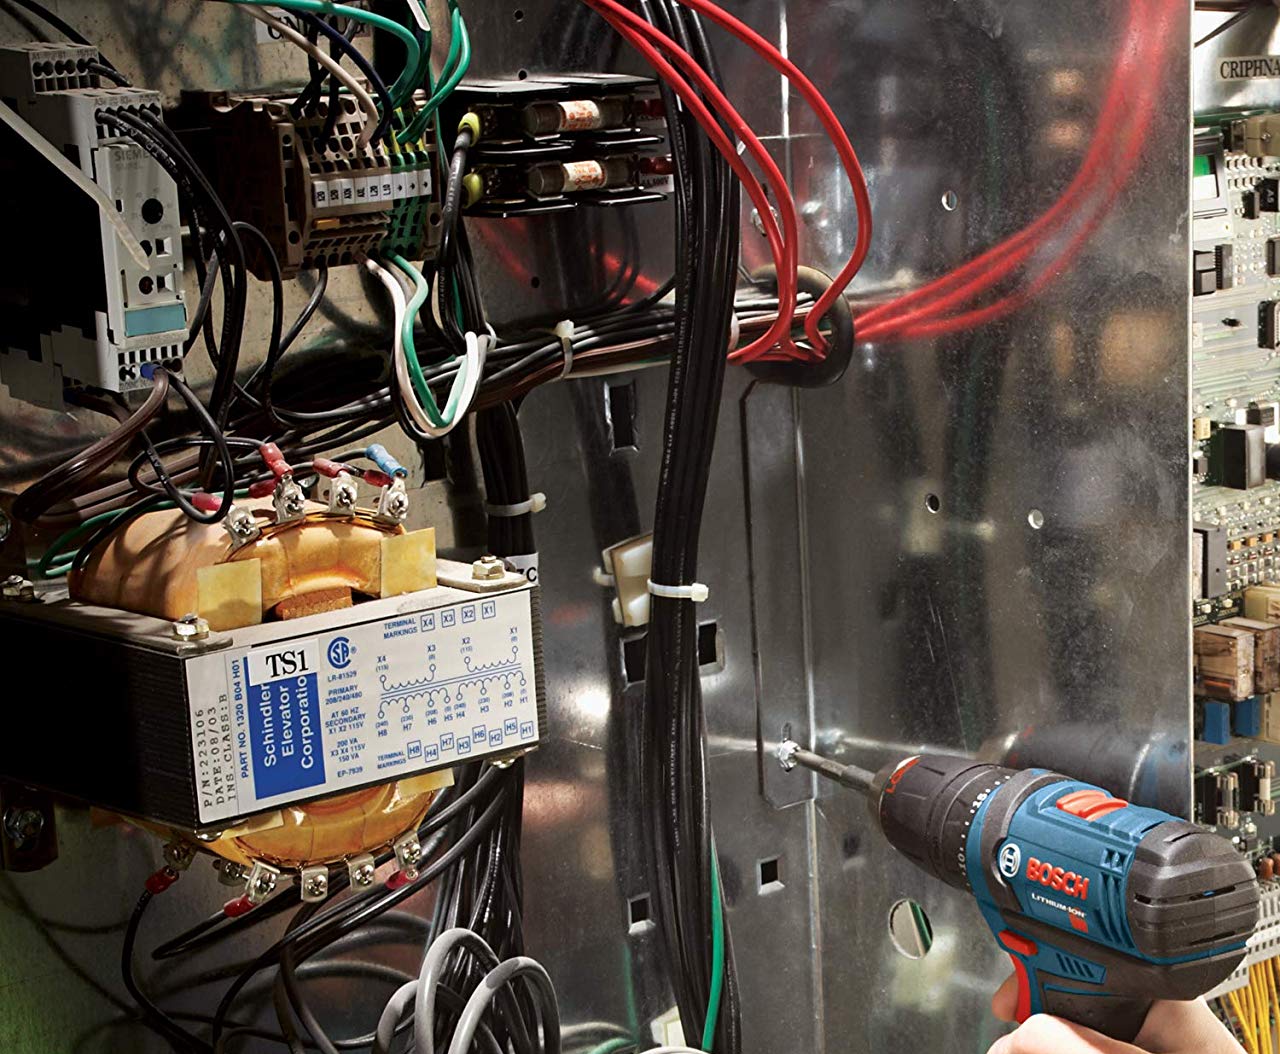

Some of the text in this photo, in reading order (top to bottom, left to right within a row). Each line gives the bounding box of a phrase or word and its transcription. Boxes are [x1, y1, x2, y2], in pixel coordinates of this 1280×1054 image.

[383, 617, 416, 630] TERMINAL
[383, 627, 417, 639] MARKINGS
[265, 649, 309, 678] TS1
[328, 685, 358, 696] PRIMARY
[235, 703, 245, 727] 1320
[259, 683, 277, 767] Schindler
[279, 685, 294, 757] Elevator
[296, 675, 314, 769] Corporatio
[325, 713, 366, 728] SECONDARY
[331, 711, 339, 719] AT
[237, 730, 247, 748] NO.
[349, 737, 358, 745] VA
[195, 709, 213, 807] P/N:223106
[207, 706, 225, 805] DATE:08/03
[238, 751, 249, 778] PART
[1026, 856, 1090, 901] BOSCH
